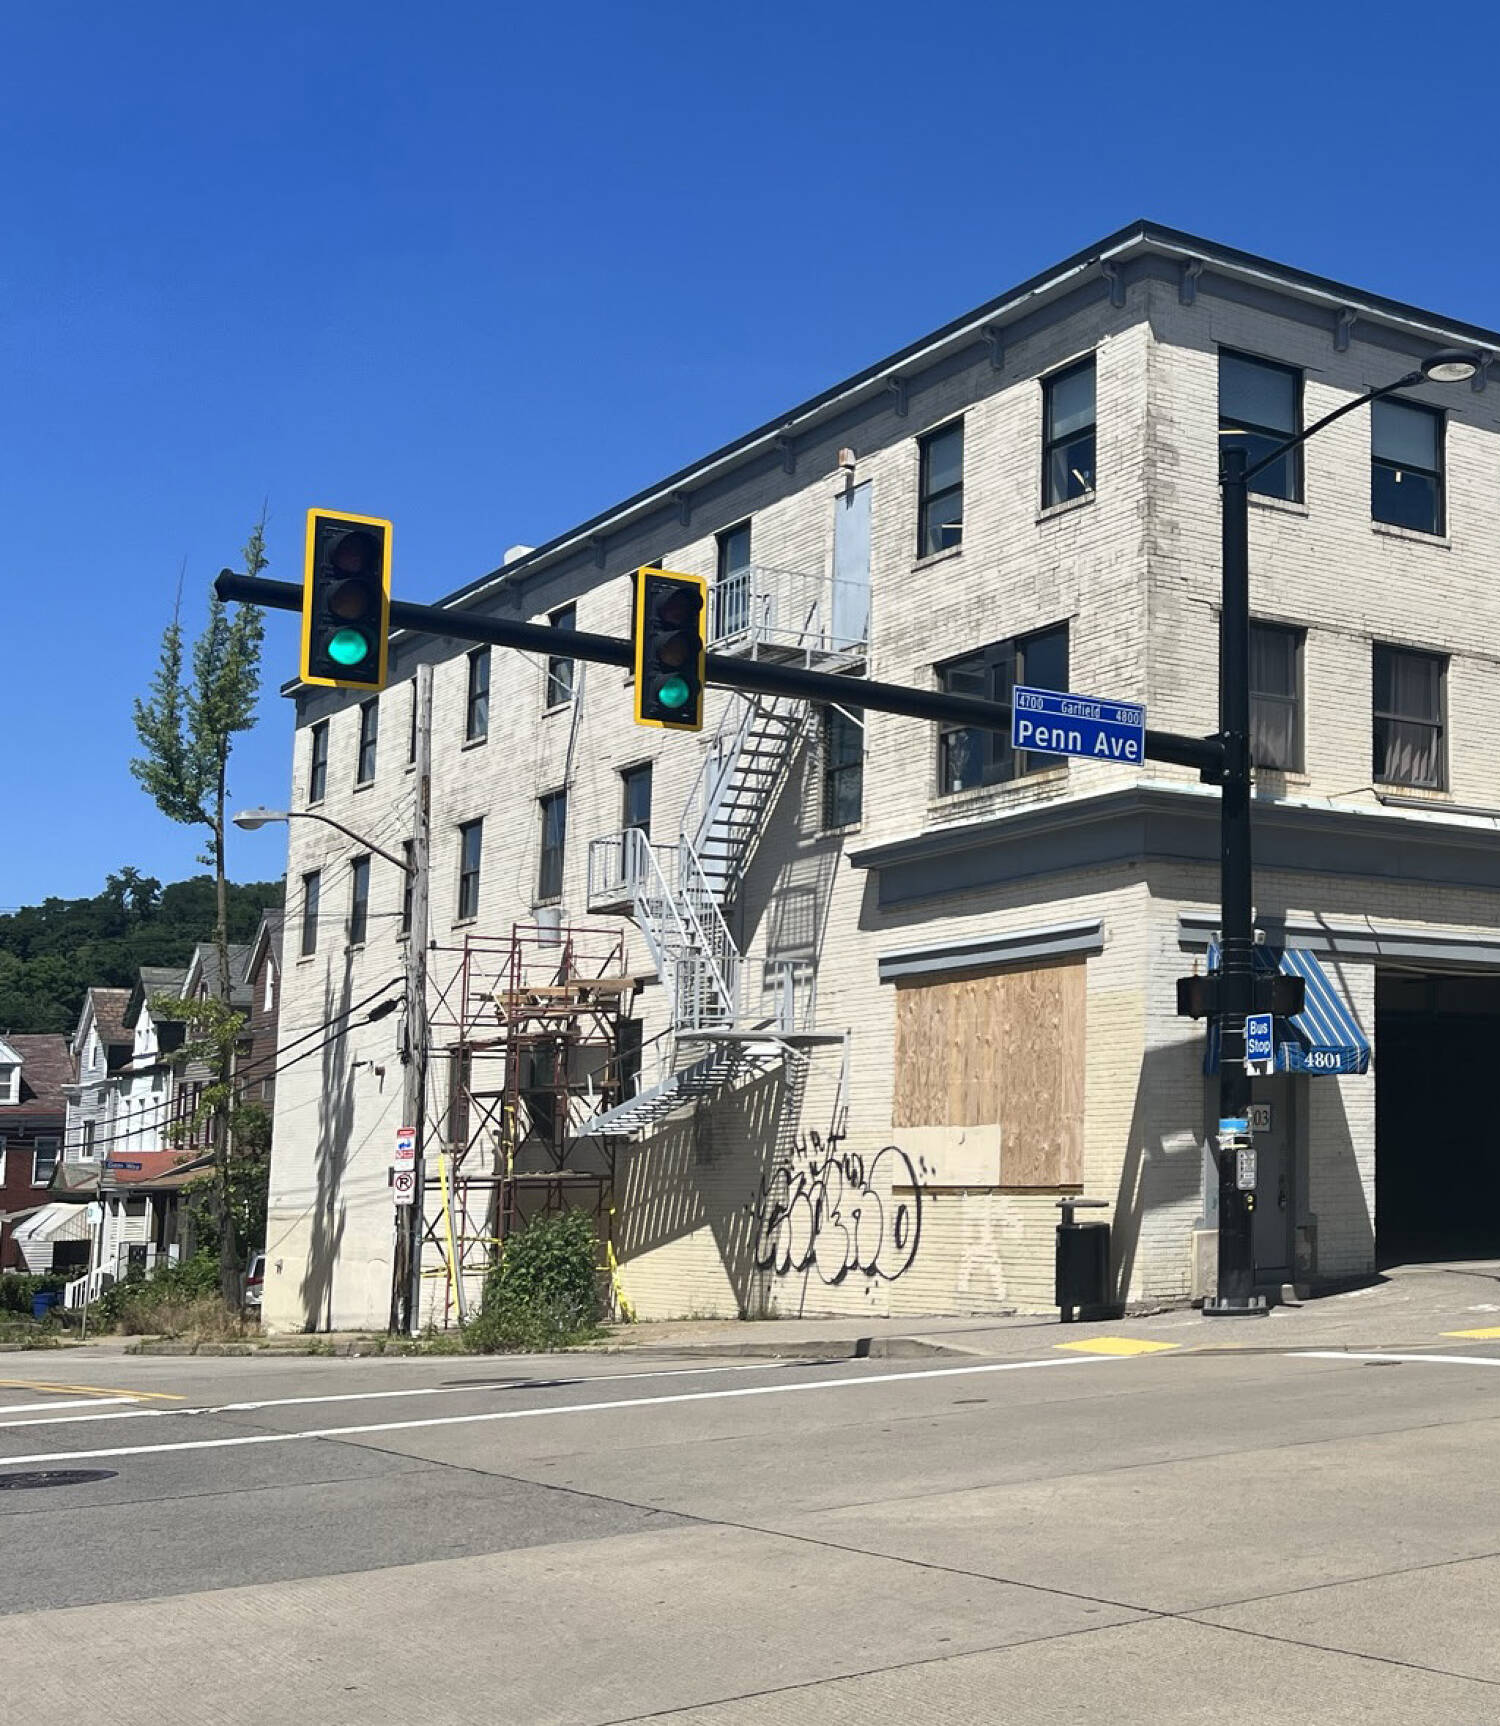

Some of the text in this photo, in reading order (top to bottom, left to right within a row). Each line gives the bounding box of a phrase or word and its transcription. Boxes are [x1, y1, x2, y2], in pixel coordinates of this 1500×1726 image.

[1018, 695, 1139, 724] 4700 Garfield 4800
[1019, 720, 1138, 759] Penn Ave
[1250, 1020, 1268, 1035] Bus
[1248, 1038, 1270, 1055] Stop
[1304, 1052, 1341, 1068] 4801
